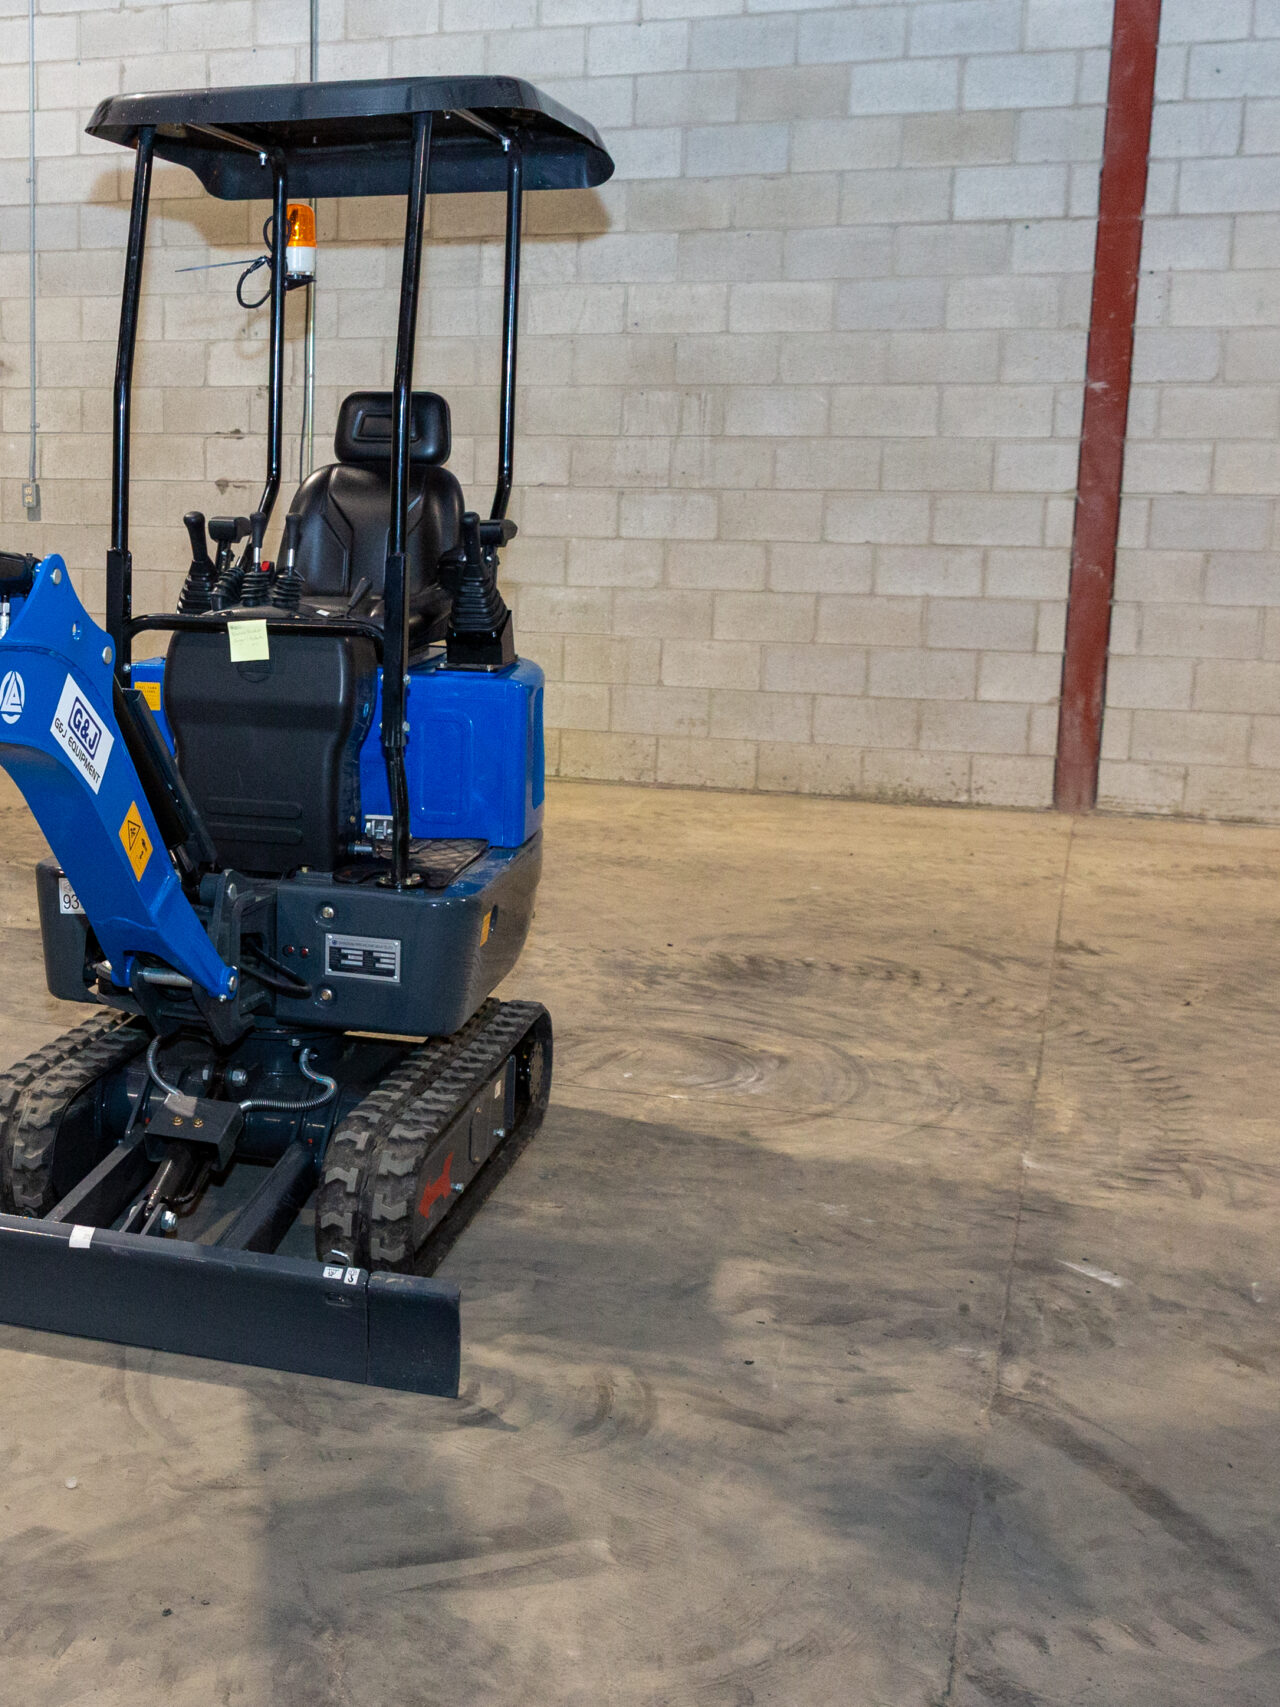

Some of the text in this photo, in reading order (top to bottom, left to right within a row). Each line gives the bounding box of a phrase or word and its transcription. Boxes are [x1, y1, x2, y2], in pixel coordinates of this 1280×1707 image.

[73, 707, 100, 750] G&J
[54, 717, 102, 784] G&J EQUIPMENT
[63, 893, 80, 910] 93
